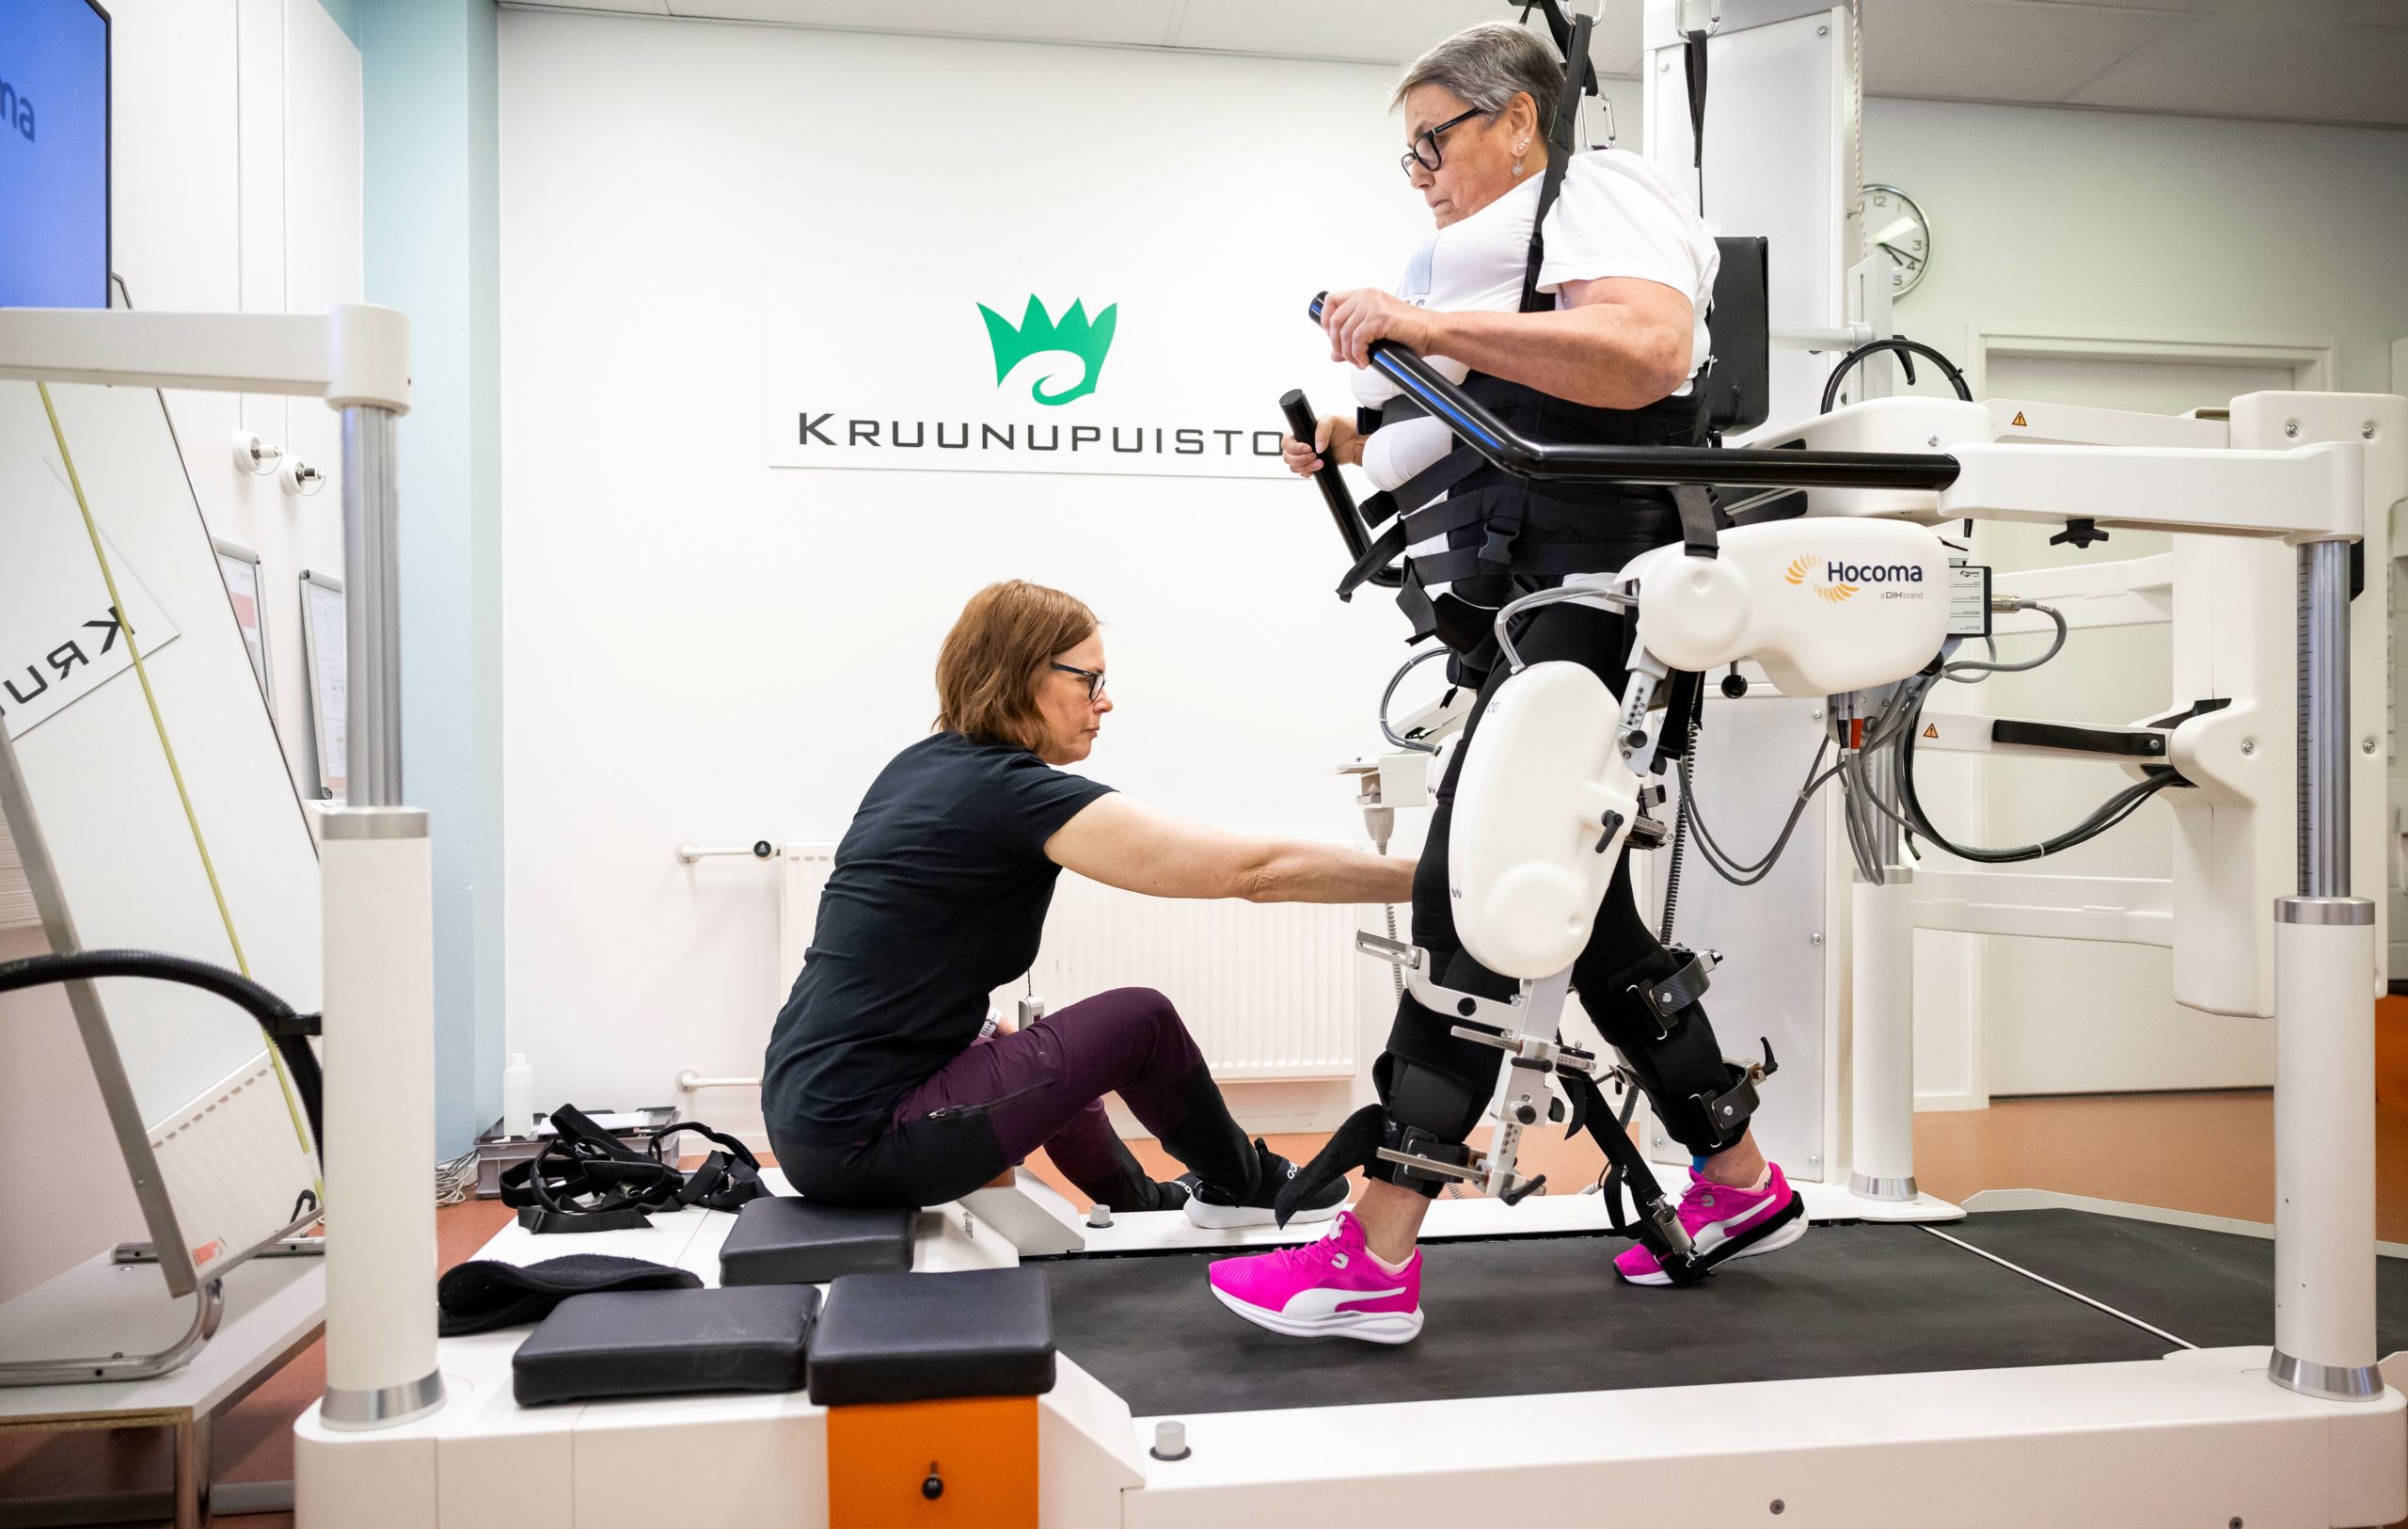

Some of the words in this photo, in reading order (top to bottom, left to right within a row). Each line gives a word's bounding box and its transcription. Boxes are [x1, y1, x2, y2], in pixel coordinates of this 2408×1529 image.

[1873, 196, 1887, 207] 12
[1911, 240, 1923, 251] 3
[1906, 262, 1916, 270] 4
[1892, 275, 1903, 286] 5
[800, 412, 1283, 456] KRUUNUPUISTO
[1828, 561, 1923, 582] Hocoma
[1885, 591, 1902, 599] DIH
[1903, 591, 1924, 599] brand
